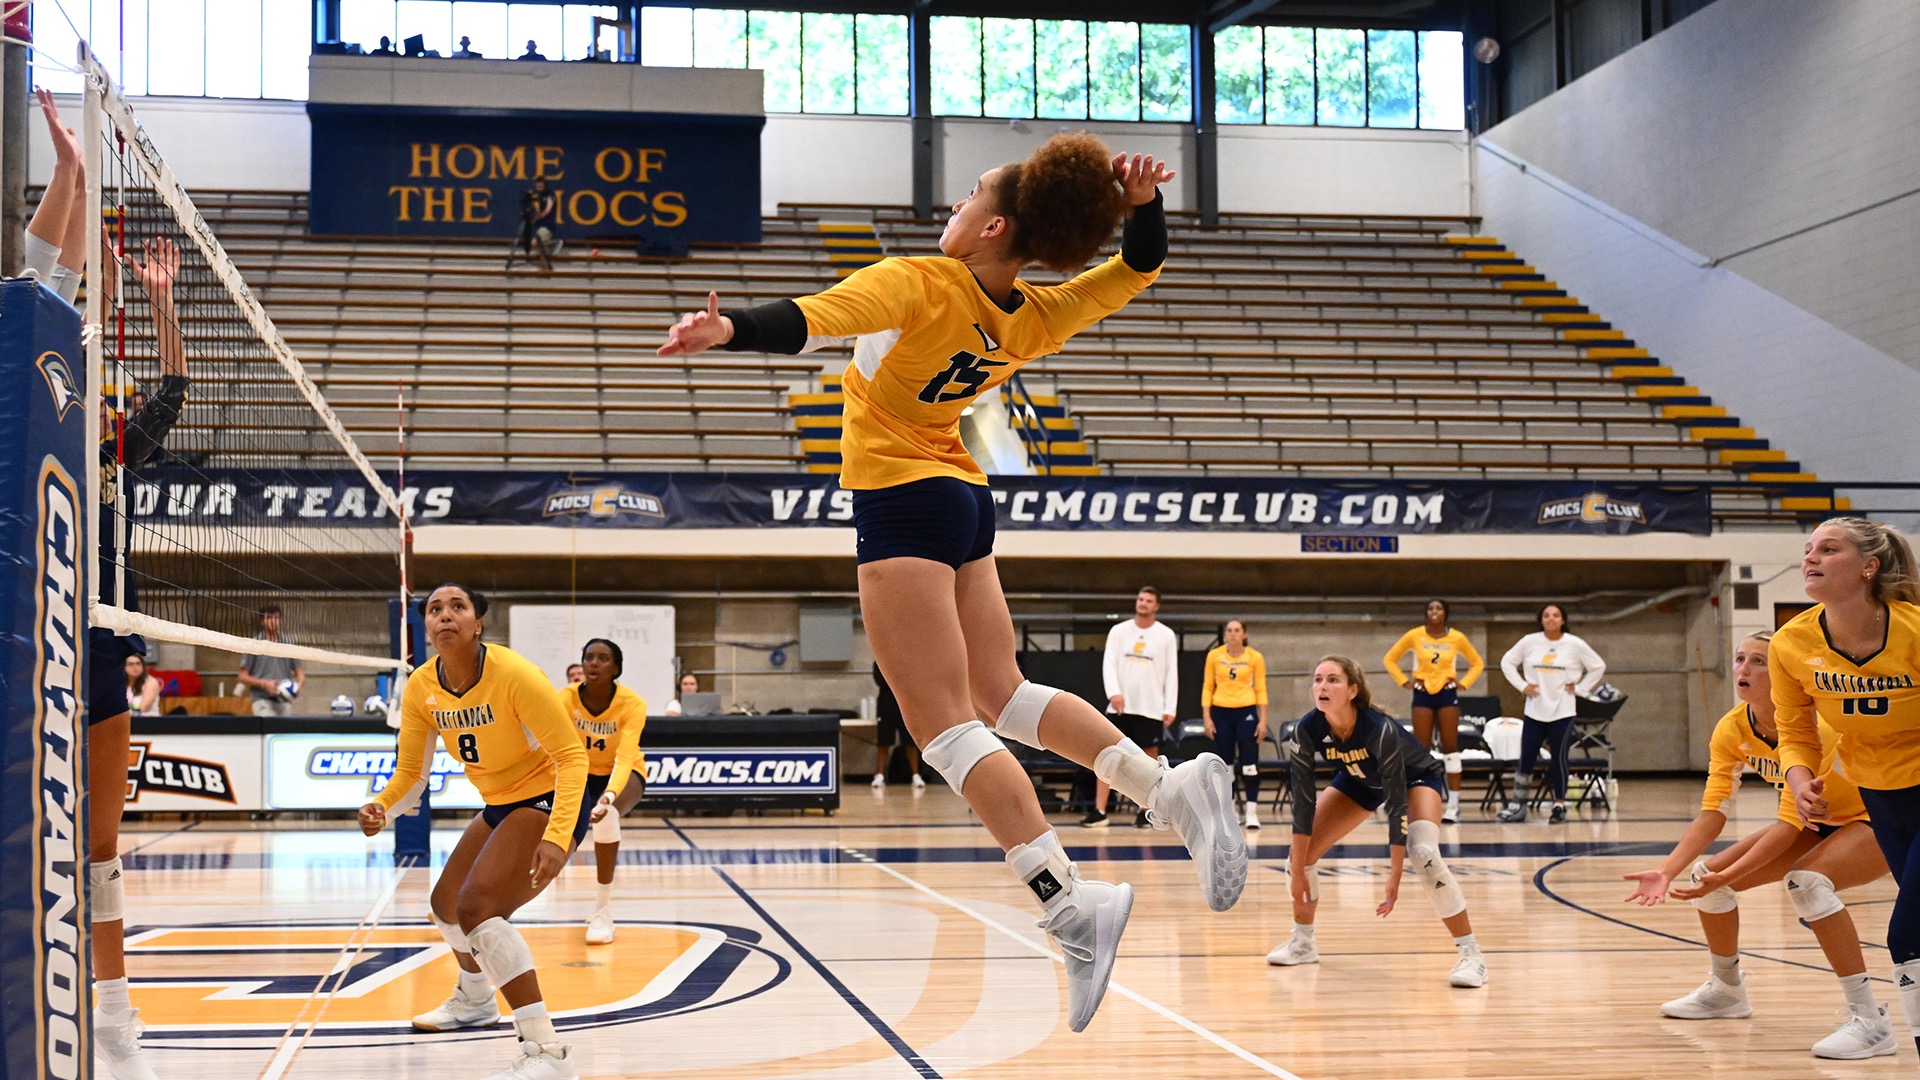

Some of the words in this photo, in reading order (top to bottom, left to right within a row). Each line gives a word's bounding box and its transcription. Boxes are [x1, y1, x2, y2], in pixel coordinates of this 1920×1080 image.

[408, 142, 564, 180] HOME
[594, 147, 668, 182] OF
[388, 186, 493, 223] THE
[554, 189, 688, 227] OCS
[916, 349, 1010, 405] 15
[134, 484, 238, 516] OUR
[263, 486, 455, 518] TEAMS
[548, 495, 591, 513] MOCS
[618, 495, 659, 513] CLUB
[770, 489, 853, 521] VIS
[1543, 502, 1580, 519] MOCS
[1304, 537, 1381, 552] SECTION
[1389, 537, 1397, 552] 1
[1431, 652, 1440, 664] 2
[1229, 667, 1237, 680] 5
[458, 733, 480, 763] 8
[586, 735, 607, 752] 14
[145, 760, 226, 794] CLUB
[645, 757, 826, 784] OMOCS.COM
[1346, 763, 1367, 779] 4
